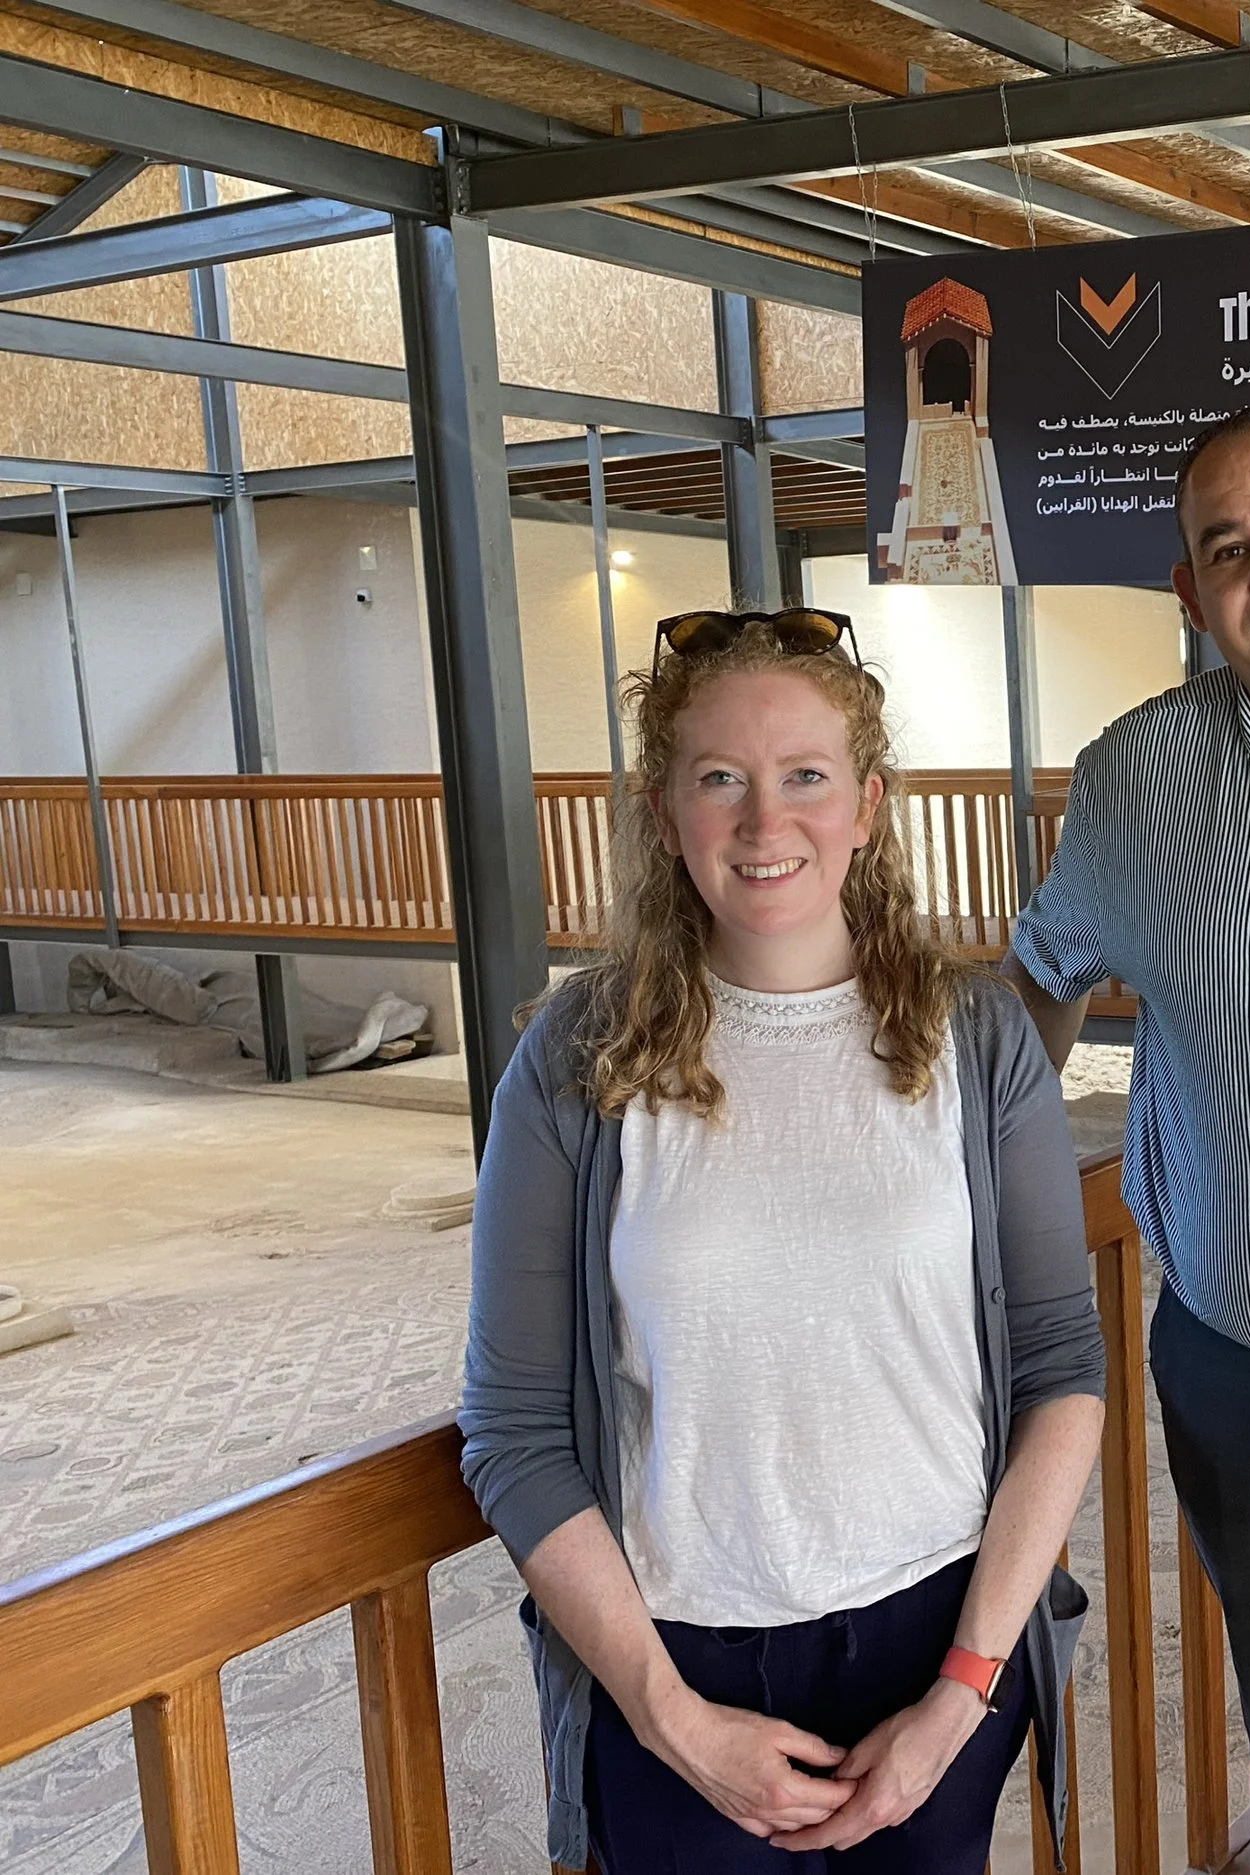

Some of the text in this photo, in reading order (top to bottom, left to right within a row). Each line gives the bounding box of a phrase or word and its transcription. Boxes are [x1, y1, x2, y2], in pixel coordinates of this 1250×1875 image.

[1038, 414, 1067, 431] فيه
[1071, 414, 1119, 430] يصطف
[1037, 447, 1064, 460] من
[1068, 441, 1109, 457] مائدة
[1112, 441, 1126, 457] به
[1130, 441, 1160, 457] توجد
[1038, 469, 1086, 488] لقدوم
[1036, 496, 1098, 515] (القرابين)
[1101, 495, 1139, 513] الهدايا
